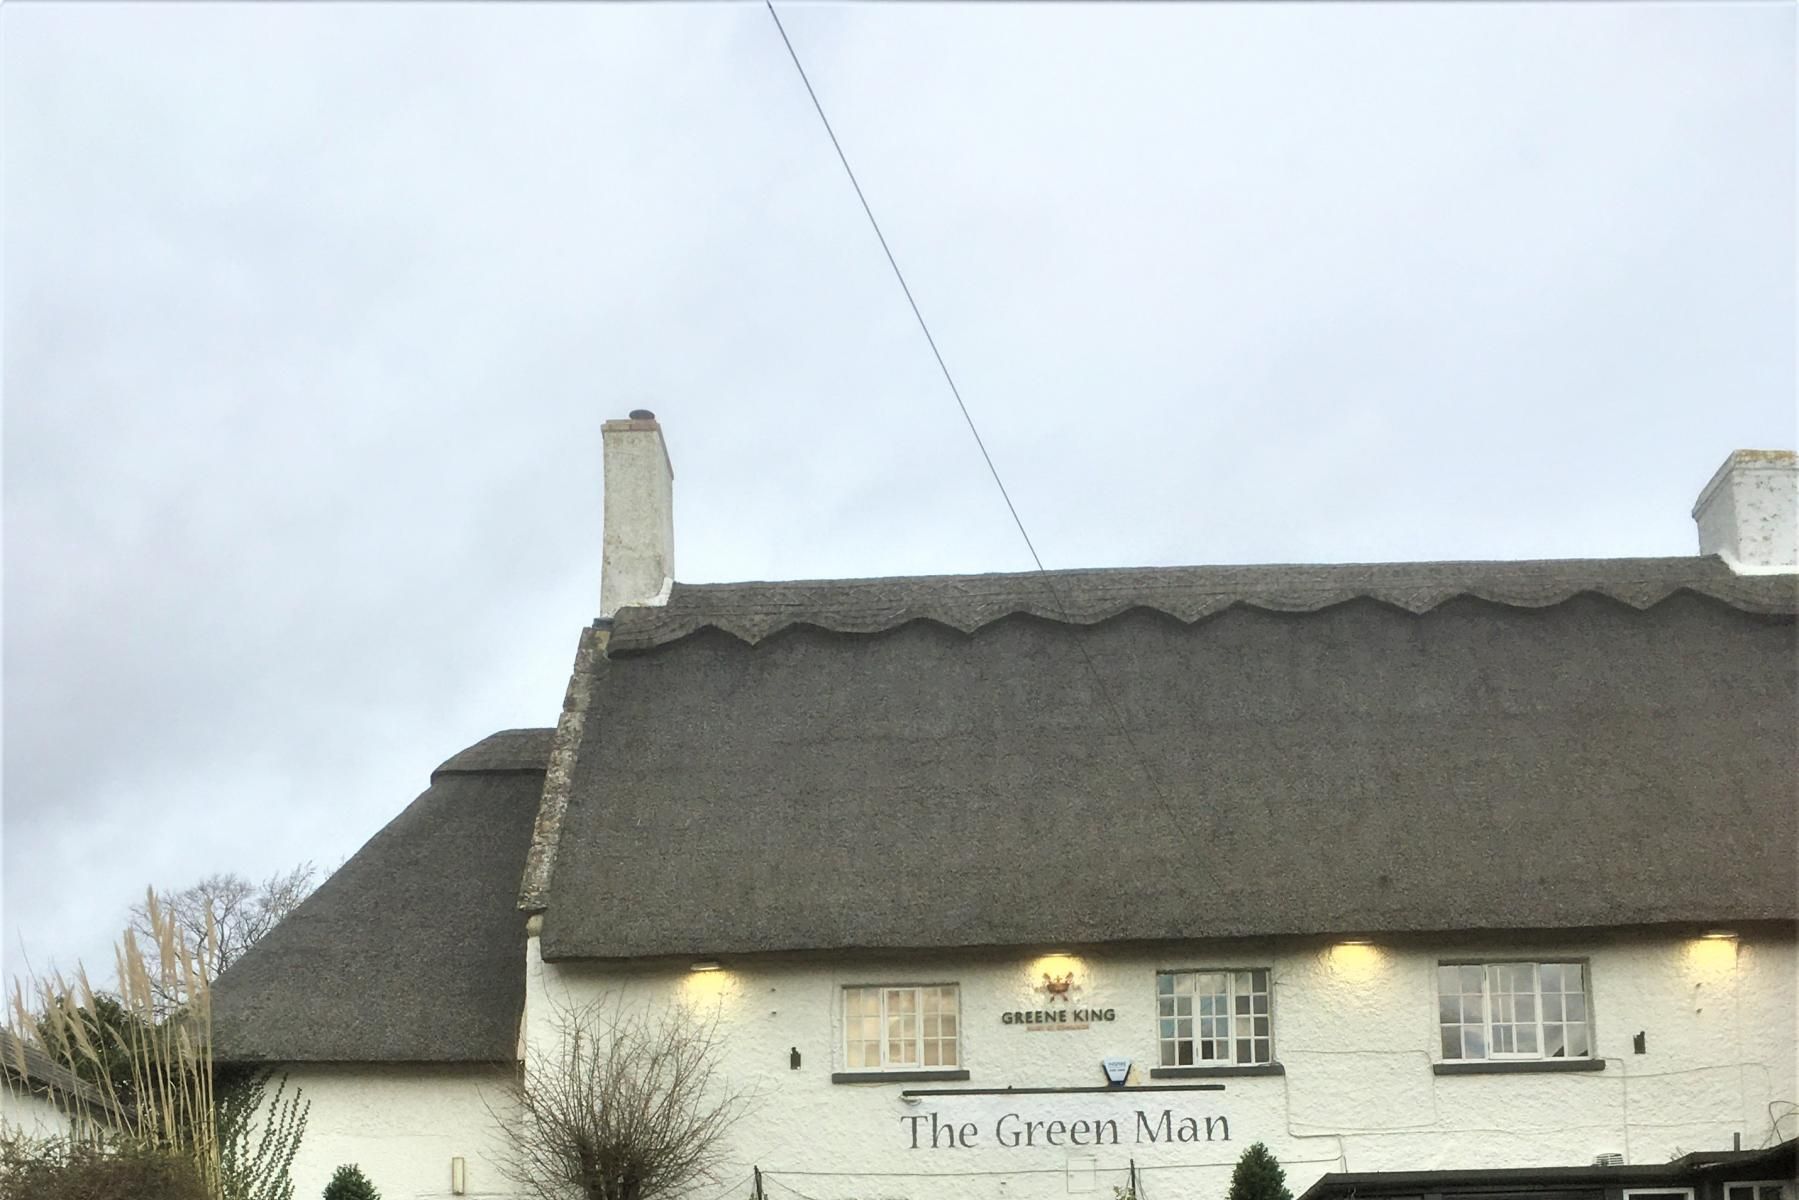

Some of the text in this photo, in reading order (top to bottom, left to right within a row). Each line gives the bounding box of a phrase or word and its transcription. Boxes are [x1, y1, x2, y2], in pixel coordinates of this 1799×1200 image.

[1001, 1009, 1116, 1025] GREENE KING
[900, 1109, 1233, 1150] The Green Man
